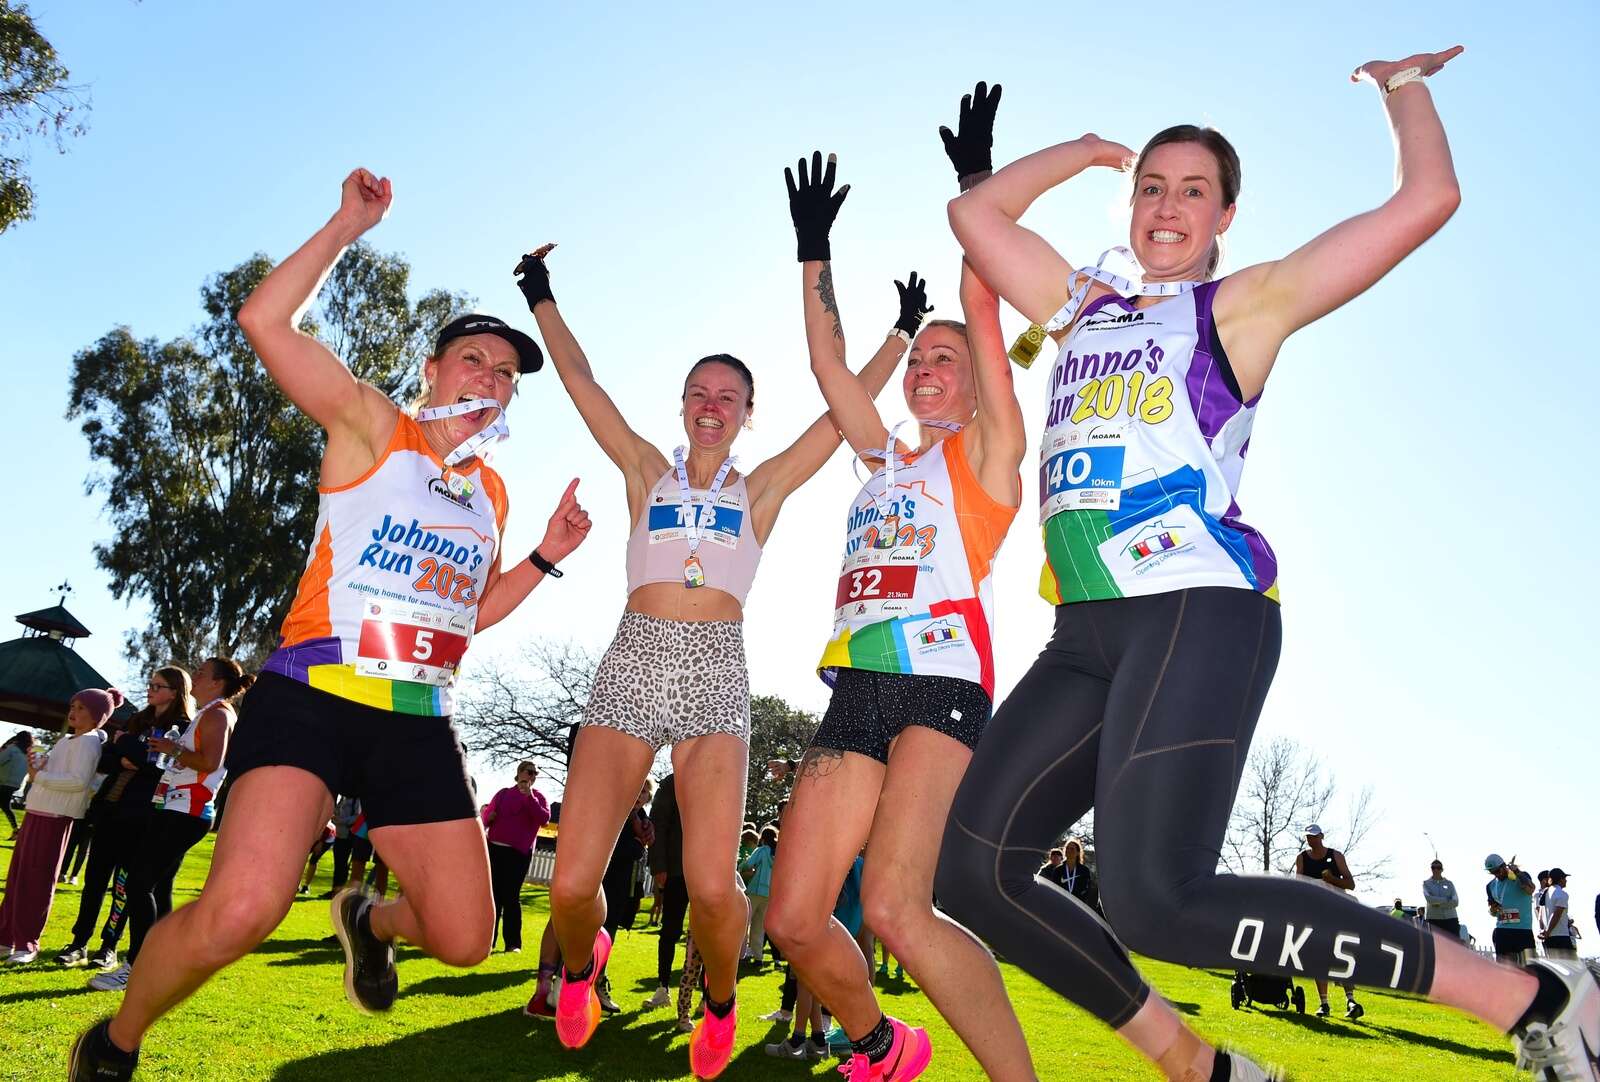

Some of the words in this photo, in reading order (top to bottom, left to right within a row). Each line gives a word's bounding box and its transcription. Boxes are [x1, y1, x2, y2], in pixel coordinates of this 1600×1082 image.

[1070, 370, 1174, 425] 2018
[1045, 451, 1092, 495] 140
[1091, 478, 1115, 488] 10km
[433, 484, 475, 510] MOA
[847, 494, 916, 535] ohno's
[372, 514, 483, 572] Johnno's
[862, 523, 938, 560] 223
[358, 542, 413, 576] Run
[381, 587, 406, 601] homes
[408, 595, 419, 606] for
[849, 569, 882, 599] 32
[412, 629, 434, 660] 5
